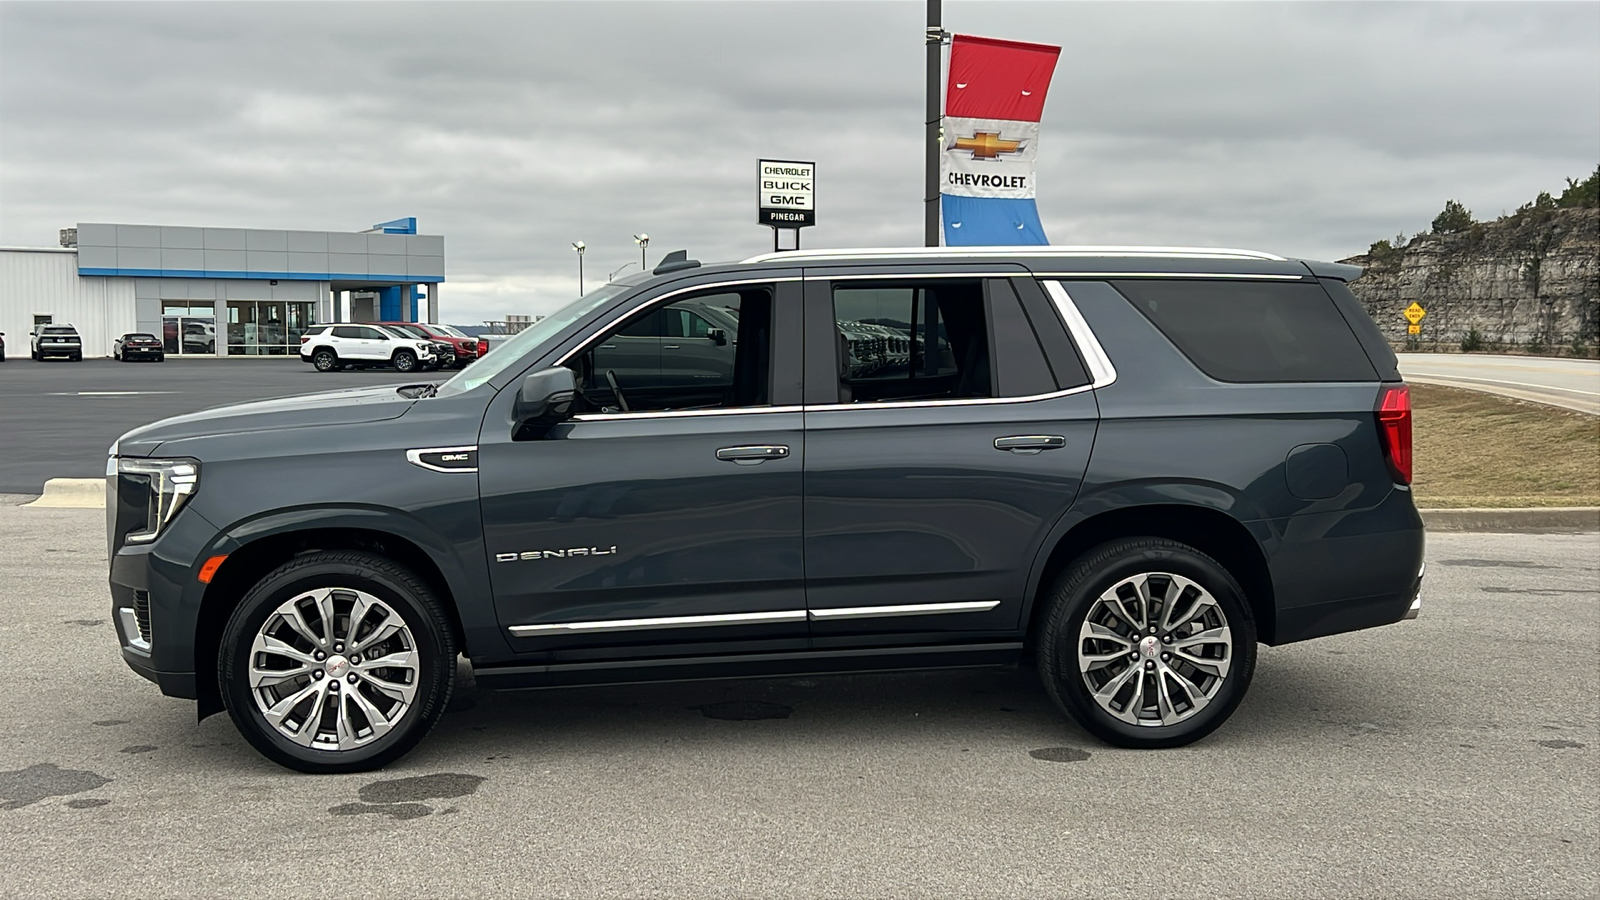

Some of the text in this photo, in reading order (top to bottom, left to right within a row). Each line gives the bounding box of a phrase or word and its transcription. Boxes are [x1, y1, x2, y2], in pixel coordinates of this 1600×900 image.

[764, 166, 811, 177] CHEVROLET
[949, 172, 1026, 189] CHEVROLET
[763, 181, 811, 191] BUICK
[770, 195, 805, 205] GMC
[770, 212, 805, 221] PINEGAR
[496, 545, 617, 562] DENALI
